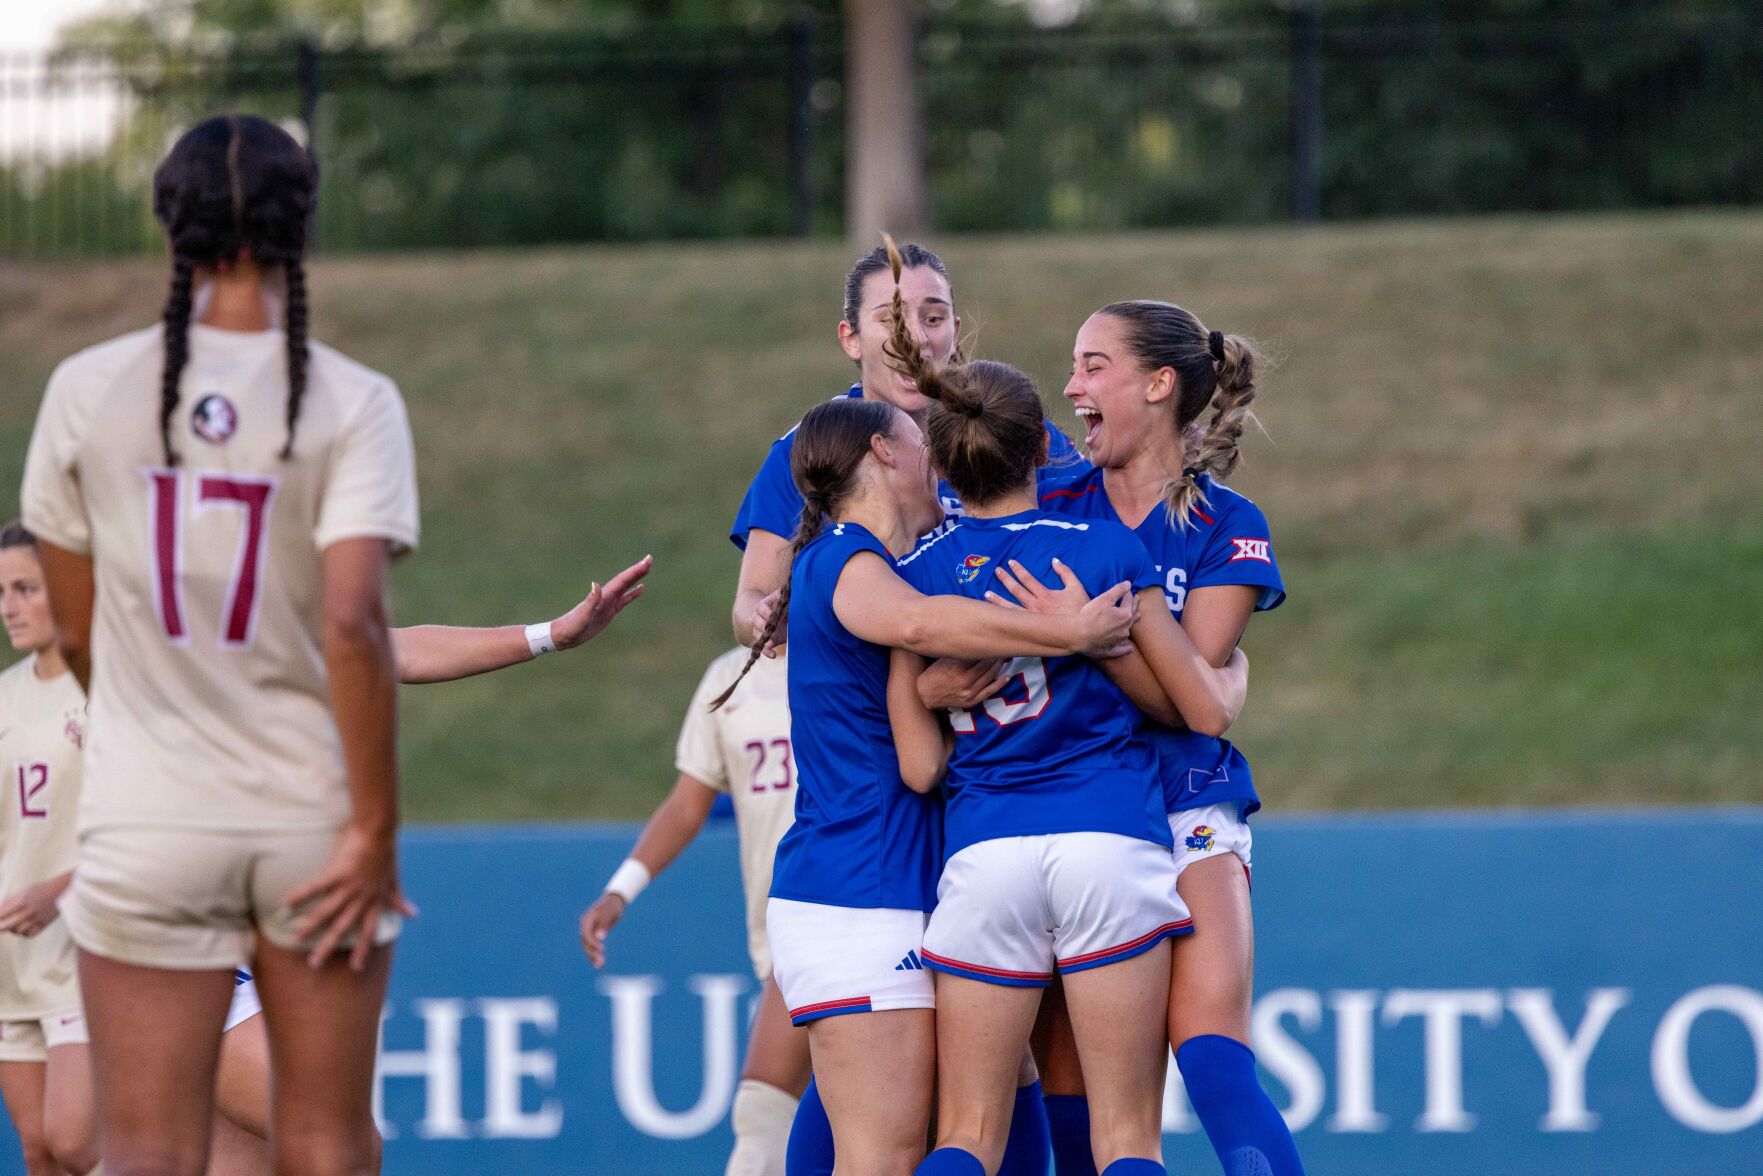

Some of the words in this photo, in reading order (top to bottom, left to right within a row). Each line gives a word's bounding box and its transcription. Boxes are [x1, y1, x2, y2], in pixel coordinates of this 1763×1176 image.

[147, 467, 278, 649] 17
[1231, 538, 1271, 563] XII
[18, 762, 49, 819] 12
[745, 738, 791, 793] 23
[372, 995, 564, 1140] HE
